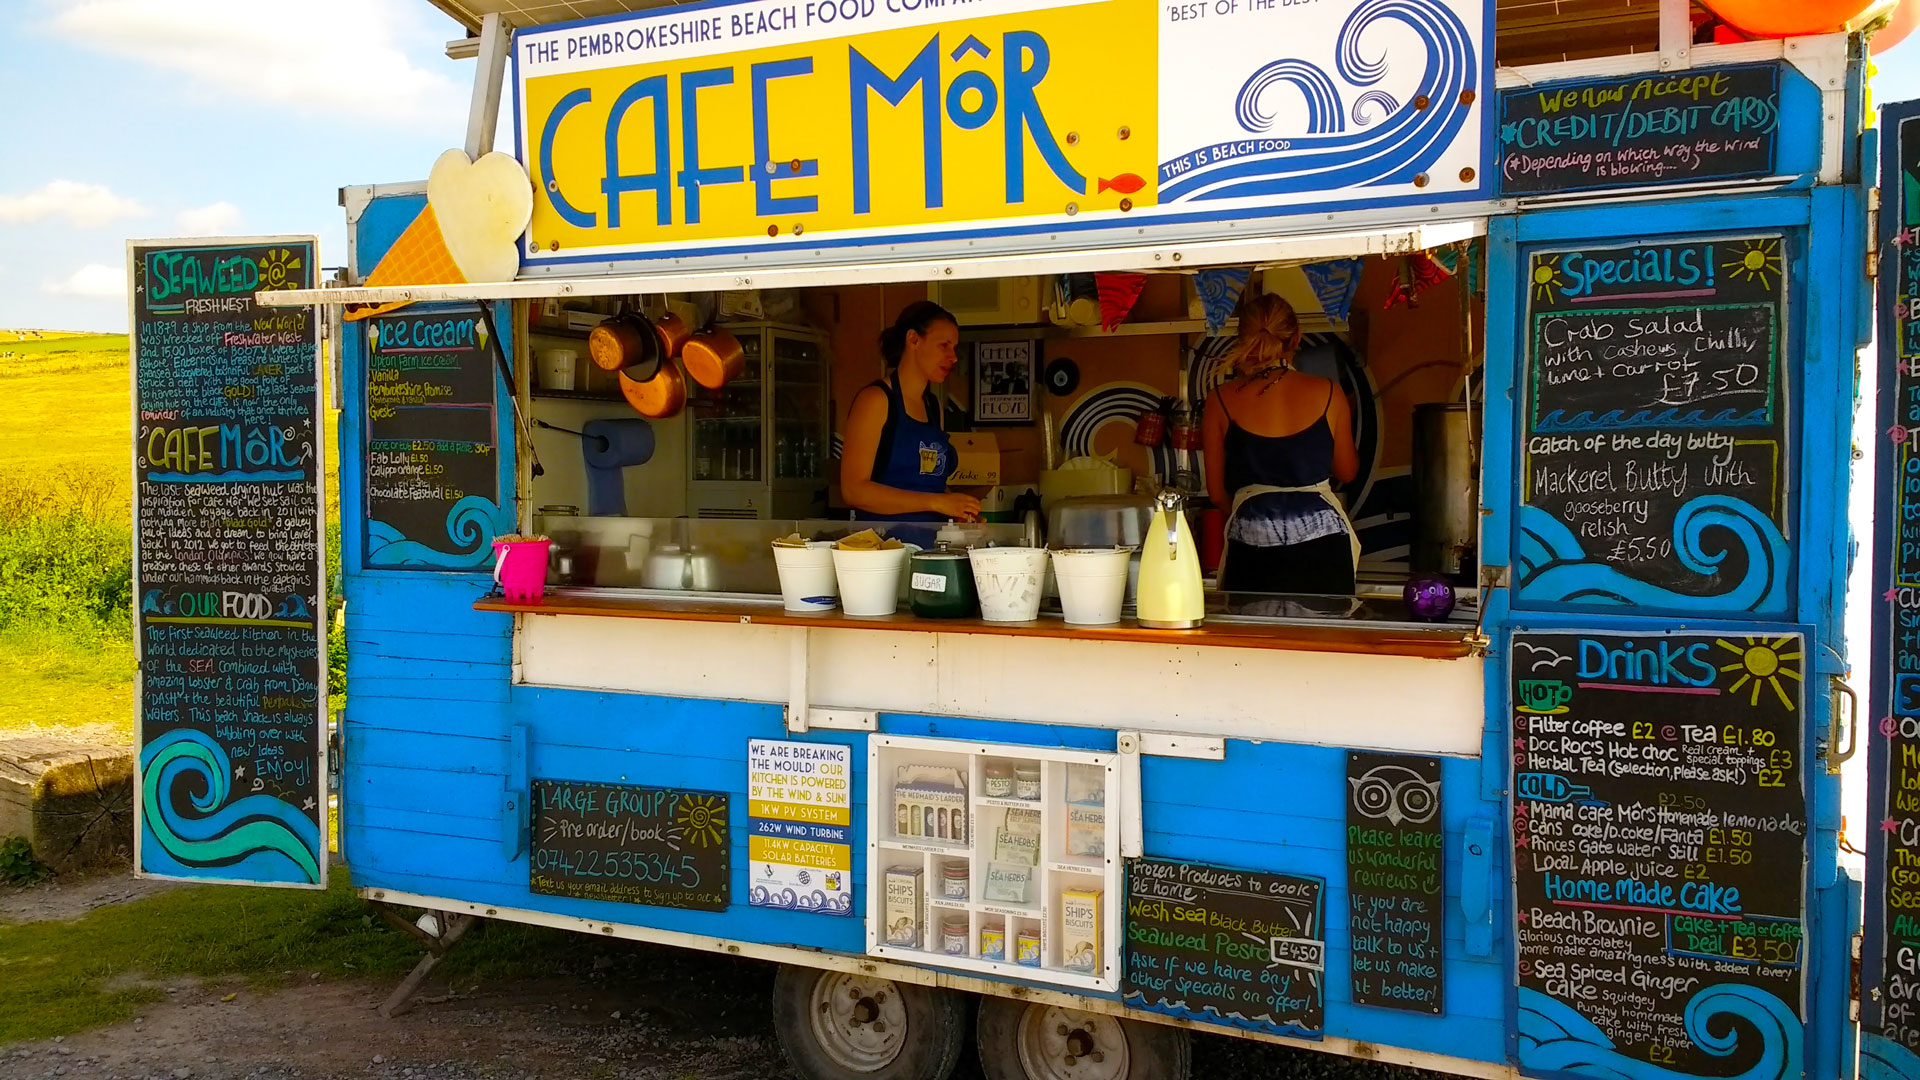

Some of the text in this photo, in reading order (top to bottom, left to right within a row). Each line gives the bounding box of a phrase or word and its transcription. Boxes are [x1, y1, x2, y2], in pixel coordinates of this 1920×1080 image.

[1216, 0, 1238, 15] OF
[526, 40, 559, 64] THE
[568, 18, 721, 59] PEMBROKESHIRE
[731, 6, 796, 37] BEACH
[807, 0, 874, 26] FOOD
[1631, 72, 1731, 100] Accept
[1518, 93, 1779, 149] CREDIT/DEBIT CARDS
[540, 56, 818, 228] CAFE
[1618, 147, 1661, 161] which
[1664, 143, 1691, 162] way
[1695, 140, 1720, 153] the
[1162, 140, 1290, 177] THIS IS BEACH FOOD
[152, 251, 259, 300] SEAWEED
[154, 321, 177, 333] 1879
[380, 319, 474, 347] Ice Cream
[1545, 319, 1614, 347] Crab
[1545, 349, 1593, 367] with
[148, 425, 220, 473] CAFE
[371, 453, 388, 464] Fab
[390, 452, 410, 466] Lolly
[1529, 431, 1734, 466] Catch of the day butty
[1535, 460, 1688, 497] Mackerel Butty
[1564, 499, 1649, 523] gooseberry
[1581, 518, 1630, 537] relish
[1607, 536, 1671, 561] £5.50
[914, 575, 941, 589] SUGAR
[179, 590, 272, 619] OUR FOOD
[189, 659, 215, 674] SEA
[1522, 682, 1560, 700] HOT
[1632, 722, 1656, 740] £2
[1680, 724, 1717, 743] Tea
[1723, 725, 1775, 746] £1.80
[751, 745, 843, 761] WE ARE BREAKING
[1770, 750, 1792, 768] £3
[752, 758, 843, 775] THE MOULD! OUR
[1582, 757, 1605, 774] Tea
[1759, 770, 1786, 787] £2
[752, 772, 846, 789] KITCHEN IS POWERED
[991, 780, 1009, 788] PESTO
[1518, 774, 1568, 796] COLD
[541, 786, 599, 819] LARGE
[752, 786, 762, 796] BY
[767, 787, 784, 798] THE
[788, 789, 812, 801] WIND
[784, 806, 796, 817] PV
[801, 808, 838, 821] SYSTEM
[759, 822, 843, 839] 262W WIND TURBINE
[1000, 834, 1035, 848] SEA HERBS
[1348, 826, 1395, 848] Please
[1710, 827, 1751, 846] £1.50
[763, 850, 836, 867] SOLAR BATTERIES
[793, 842, 834, 854] CAPACITY
[1706, 848, 1752, 864] £1.50
[1684, 864, 1710, 880] £2
[888, 884, 913, 896] SHIP'S
[888, 896, 913, 905] BISCUITS
[1269, 882, 1311, 897] cook
[1546, 872, 1612, 901] Home
[1680, 881, 1742, 914] Cake
[1066, 906, 1093, 919] SHIP'S
[1368, 896, 1396, 918] you
[1401, 898, 1428, 912] are
[1066, 919, 1093, 929] BISCUITS
[1173, 908, 1298, 938] sea Black Butter
[1352, 912, 1430, 943] not happy
[1530, 907, 1582, 930] Beach
[1582, 910, 1660, 938] Brownie
[1730, 920, 1758, 934] Tea
[1128, 921, 1209, 951] Seaweed
[1215, 932, 1271, 962] Pesto
[1688, 934, 1794, 964] Deal £3.50
[1214, 960, 1252, 982] have
[1260, 970, 1290, 996] any
[1534, 959, 1700, 1000] Sea Spiced Ginger
[1650, 1045, 1676, 1064] £2
